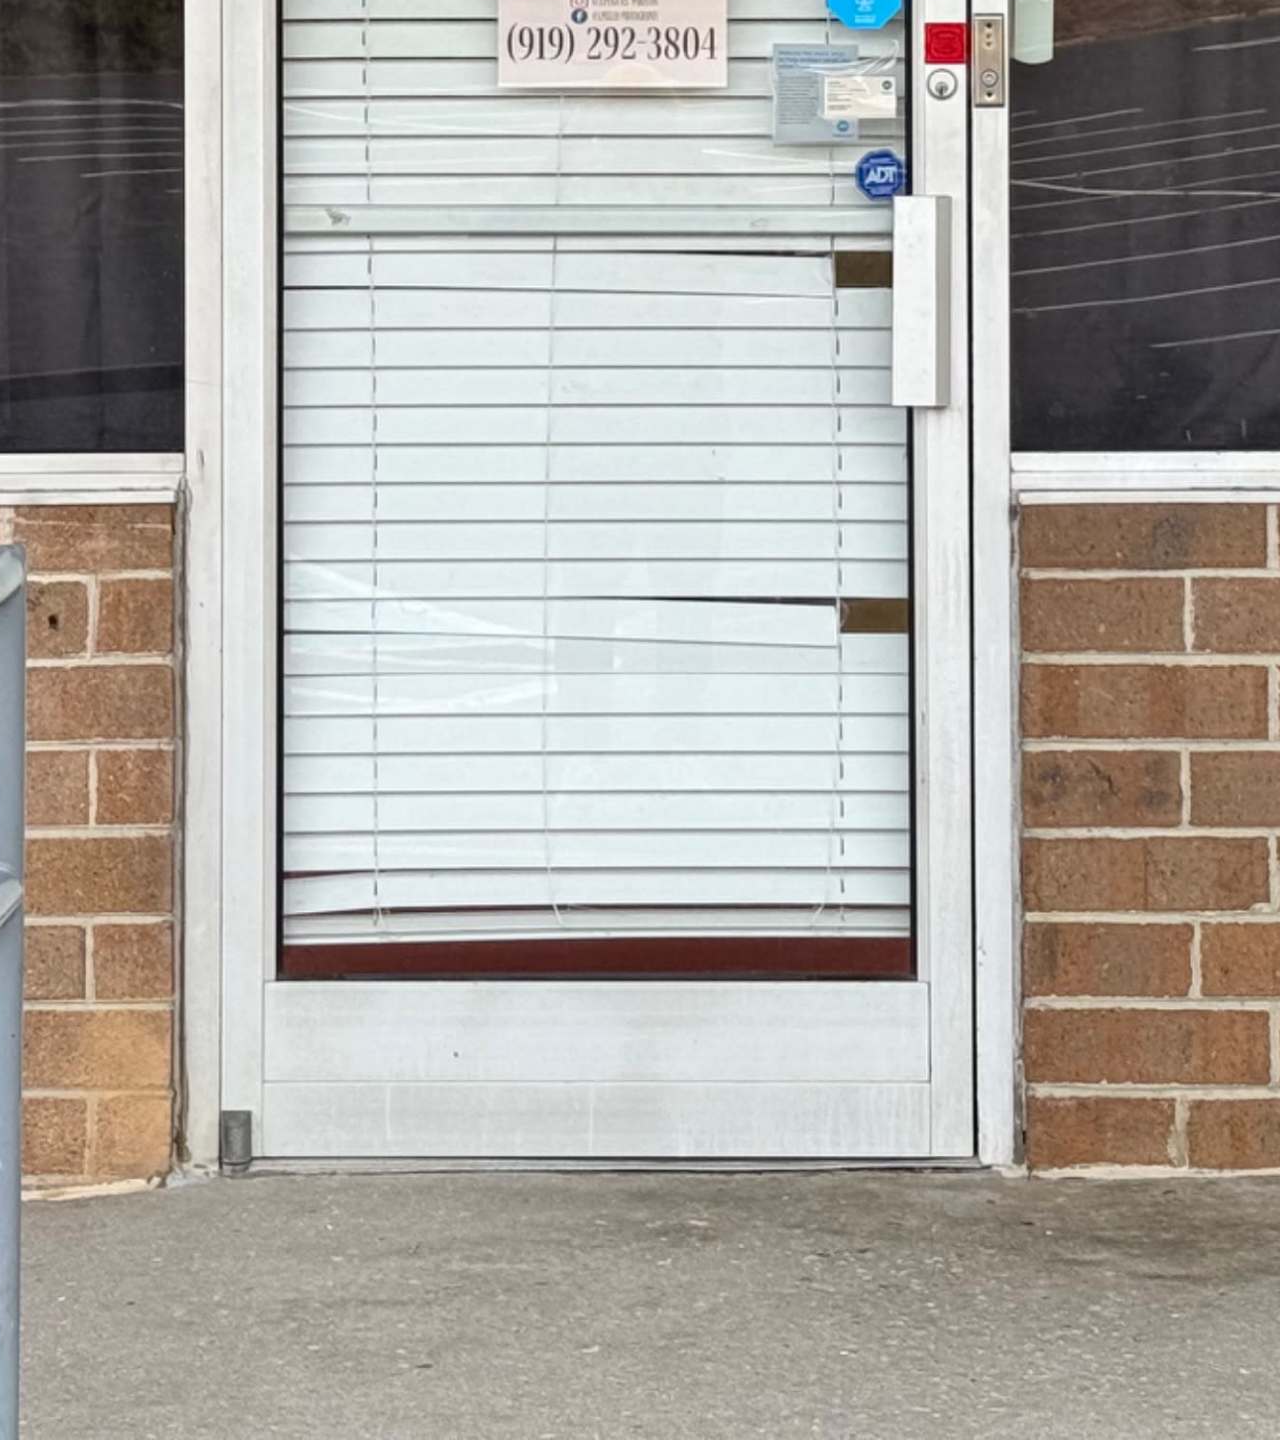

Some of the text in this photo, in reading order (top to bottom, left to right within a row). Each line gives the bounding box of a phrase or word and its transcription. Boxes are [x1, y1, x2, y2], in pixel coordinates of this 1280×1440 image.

[507, 23, 717, 64] (919) 292-3804
[864, 166, 897, 183] ADT
